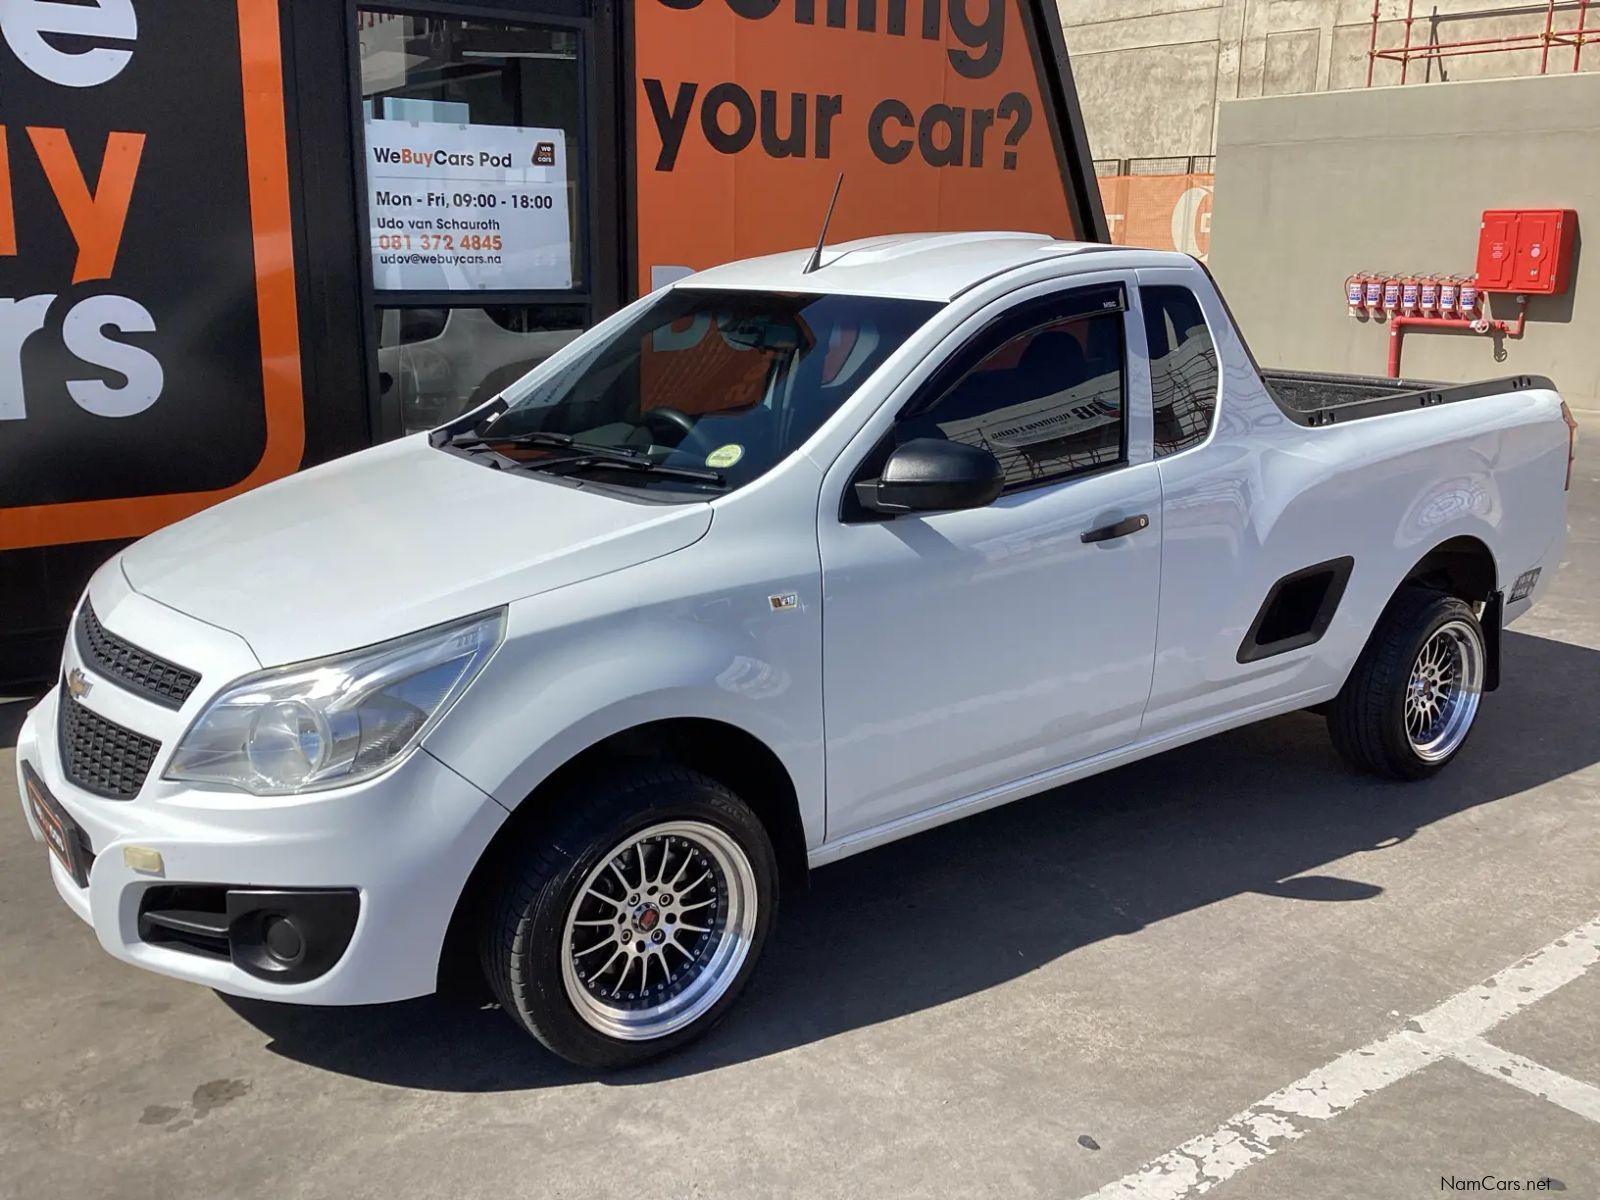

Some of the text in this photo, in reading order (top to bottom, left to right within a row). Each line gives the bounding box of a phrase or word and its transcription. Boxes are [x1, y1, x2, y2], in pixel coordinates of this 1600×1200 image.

[642, 78, 1033, 172] your car?
[373, 147, 512, 168] WeBuyCars Pod
[376, 191, 413, 206] Mon
[427, 192, 450, 208] Fri,
[453, 193, 497, 208] 09:00
[512, 194, 553, 209] 18:00
[377, 217, 500, 231] Udo van Schauroth
[378, 234, 503, 250] 081 372 4845
[380, 253, 502, 266] udov@webuycars.na
